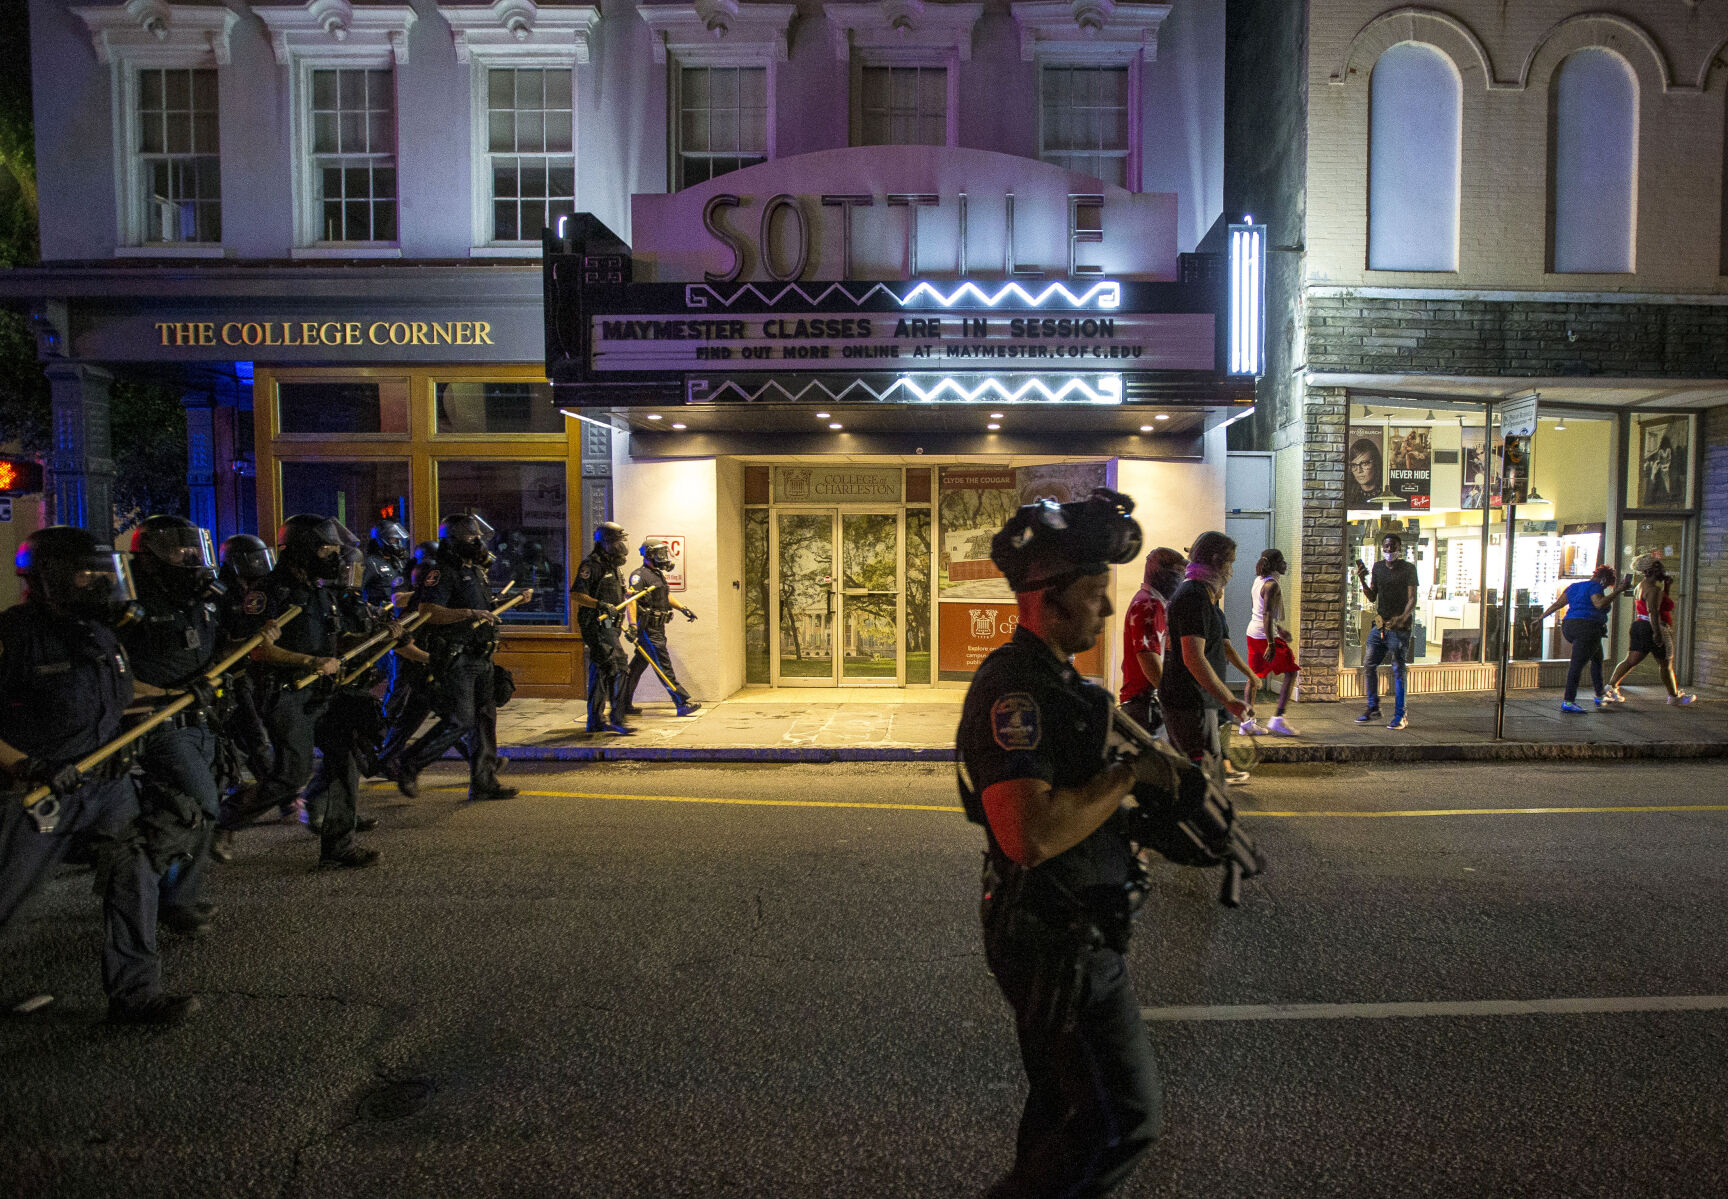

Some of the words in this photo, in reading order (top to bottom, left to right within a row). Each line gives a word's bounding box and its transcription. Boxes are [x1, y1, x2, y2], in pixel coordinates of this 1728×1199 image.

[702, 193, 1105, 282] SOTTILE
[155, 321, 217, 346] THE
[221, 321, 363, 346] COLLEGE
[368, 321, 495, 345] CORNER
[602, 319, 746, 340] MAYMESTER
[762, 318, 872, 339] CLASSES
[893, 318, 941, 338] ARE
[962, 318, 988, 337] IN
[1010, 318, 1115, 338] SESSION
[696, 346, 732, 360] FIND
[741, 346, 773, 359] OUT
[782, 345, 830, 360] MORE
[842, 345, 900, 359] ONLINE
[912, 345, 933, 358] AT
[824, 474, 878, 484] COLLEGE
[1390, 469, 1412, 479] NEVER
[1413, 470, 1430, 479] HIDE
[815, 483, 895, 495] CHARLESTON
